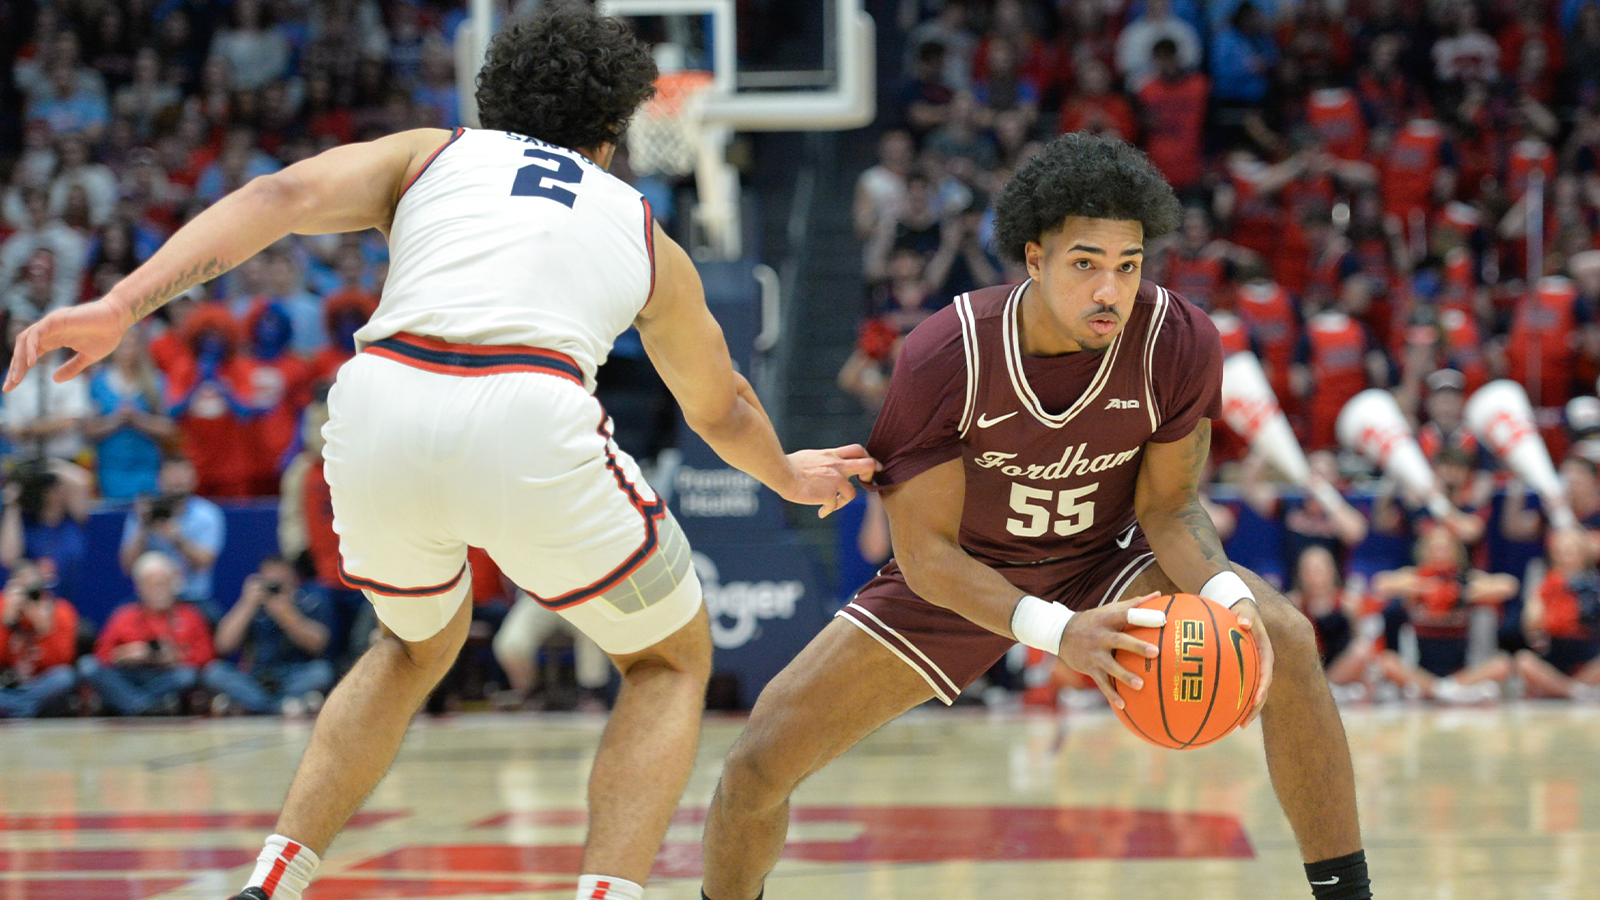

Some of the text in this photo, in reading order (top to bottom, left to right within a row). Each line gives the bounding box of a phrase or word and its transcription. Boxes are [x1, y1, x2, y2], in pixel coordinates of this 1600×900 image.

[510, 148, 584, 210] 2
[974, 442, 1140, 480] Fordham
[1006, 482, 1099, 537] 55
[1174, 619, 1182, 701] CHAMPIONSHIP
[1180, 619, 1205, 702] ELITE
